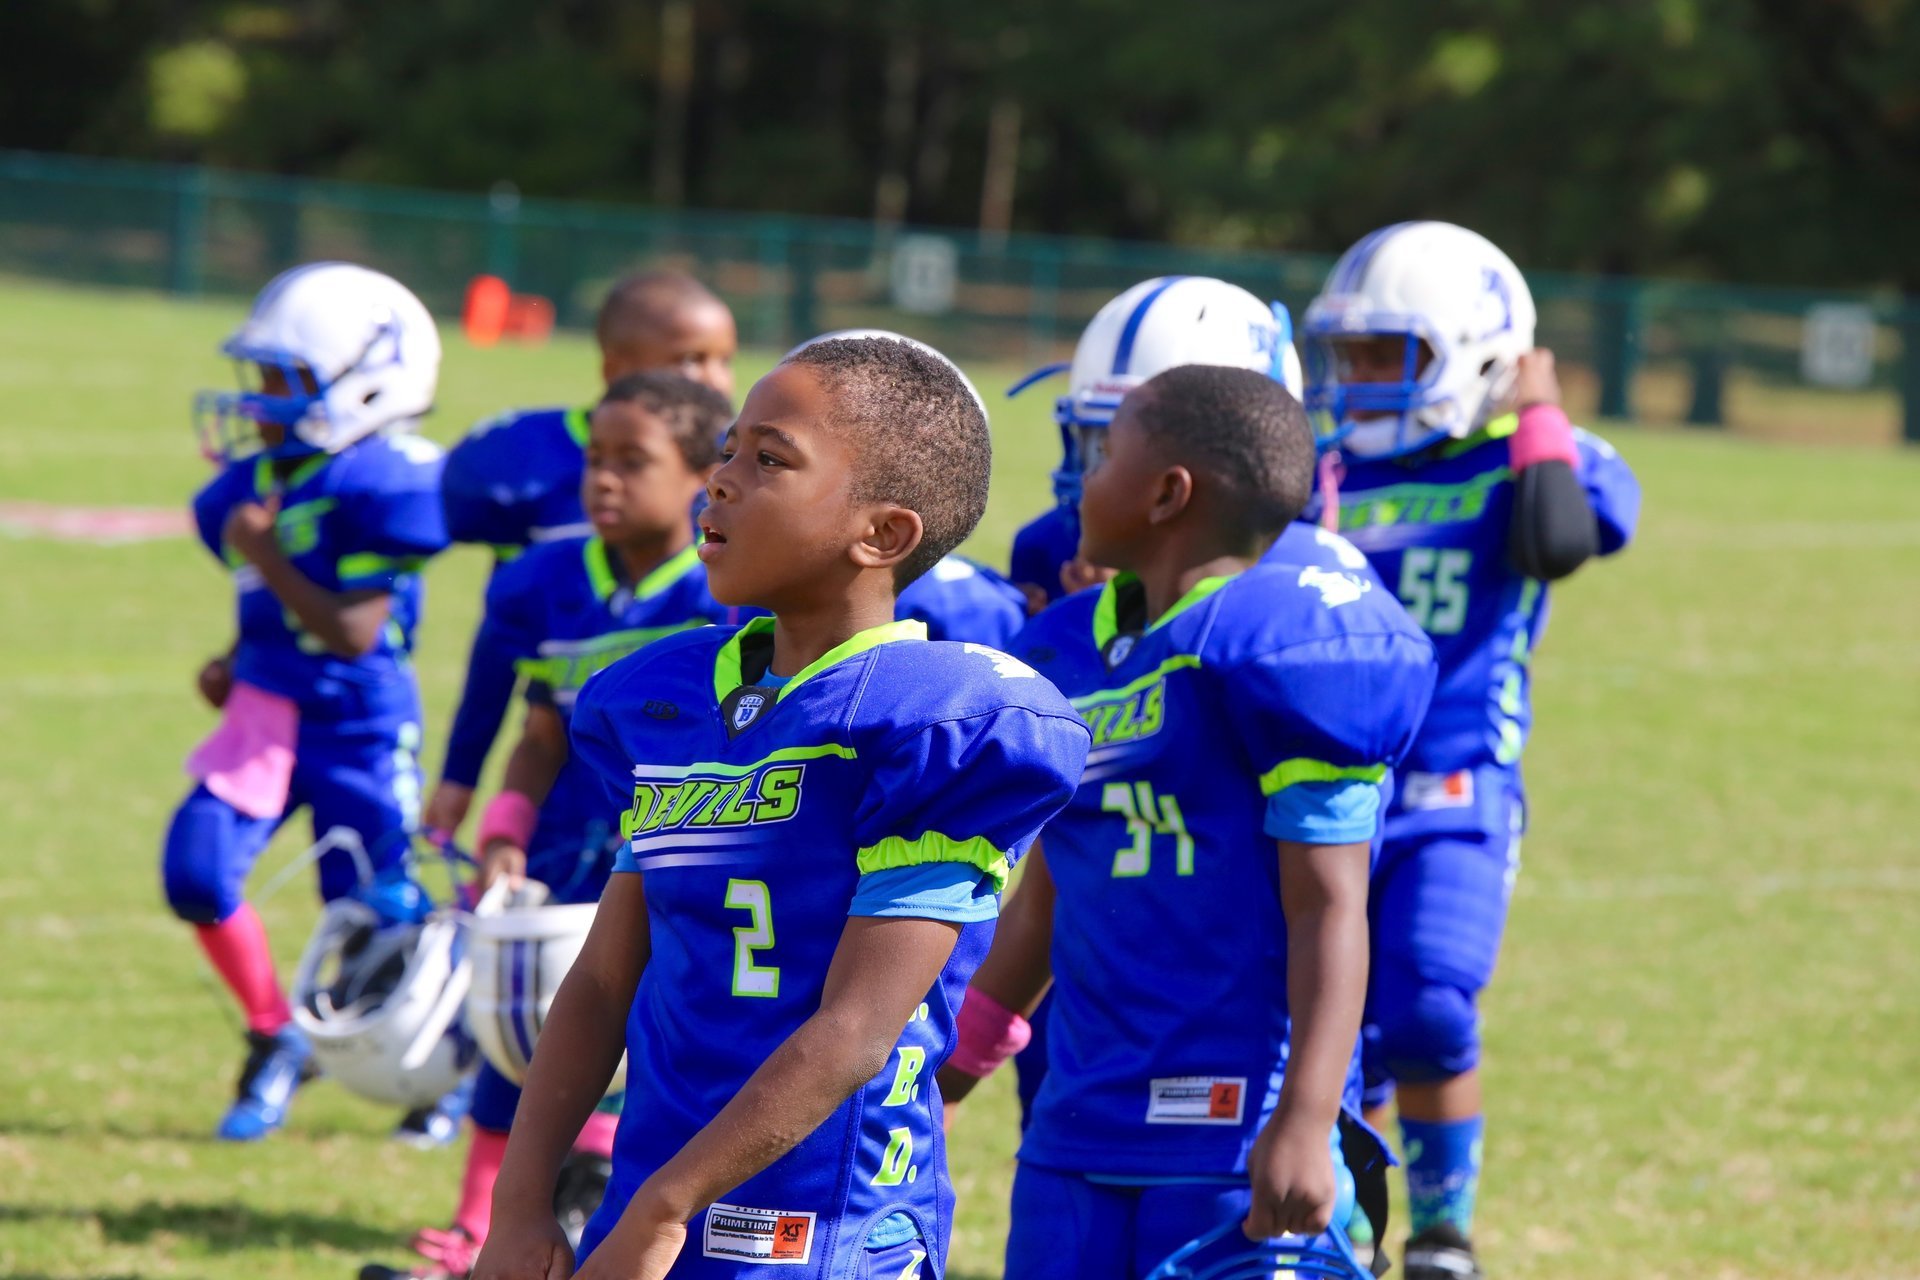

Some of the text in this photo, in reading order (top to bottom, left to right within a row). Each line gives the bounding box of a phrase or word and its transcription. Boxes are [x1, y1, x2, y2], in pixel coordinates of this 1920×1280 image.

[1401, 546, 1474, 634] 55
[631, 763, 806, 836] DEVILS
[1101, 781, 1195, 878] 34
[723, 878, 780, 998] 2
[711, 1214, 776, 1232] PRIMETIME
[780, 1222, 804, 1238] XS
